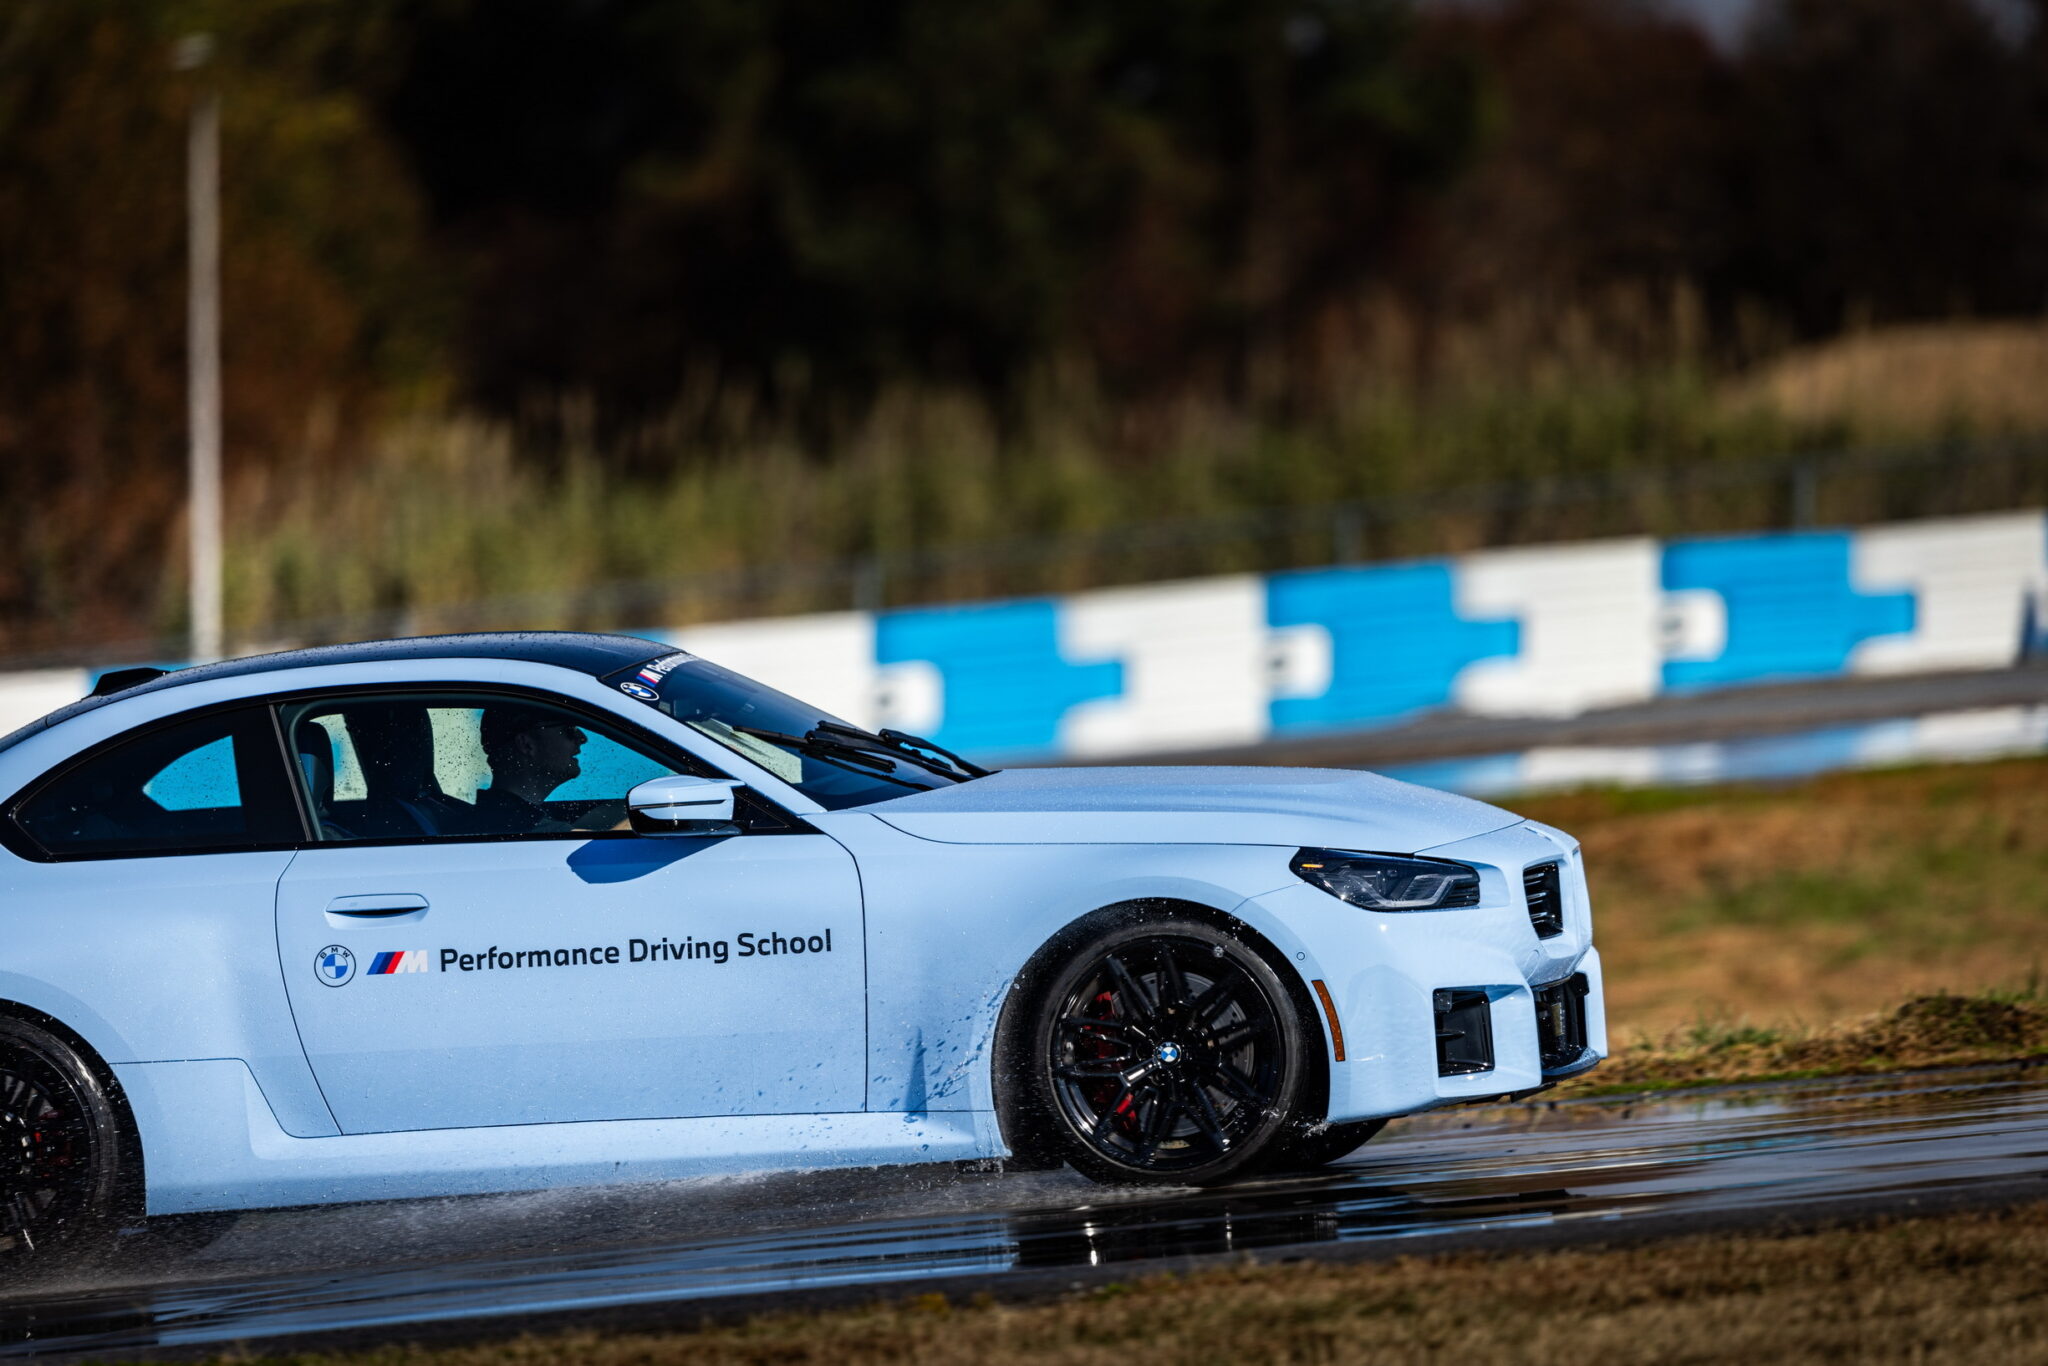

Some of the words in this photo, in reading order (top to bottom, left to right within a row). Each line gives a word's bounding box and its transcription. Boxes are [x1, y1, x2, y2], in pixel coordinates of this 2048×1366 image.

[440, 946, 620, 972] Performance
[629, 936, 728, 964] Driving
[737, 928, 832, 956] School
